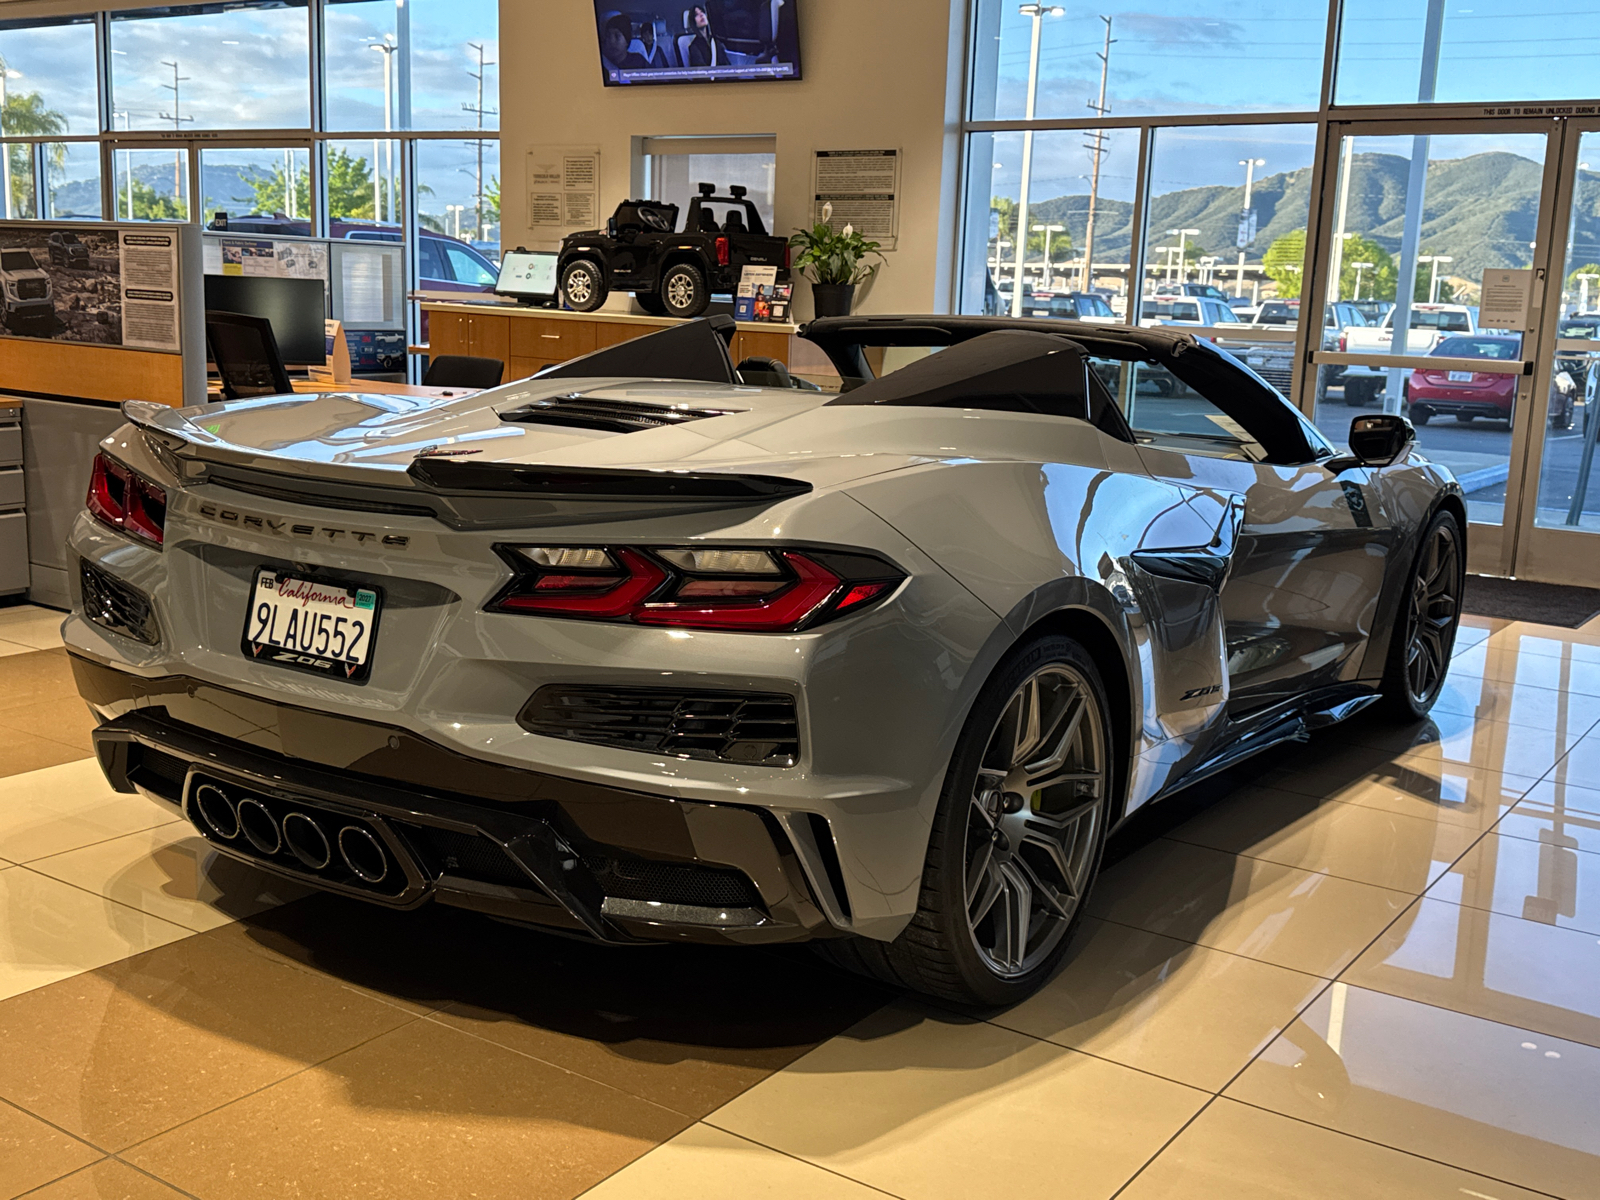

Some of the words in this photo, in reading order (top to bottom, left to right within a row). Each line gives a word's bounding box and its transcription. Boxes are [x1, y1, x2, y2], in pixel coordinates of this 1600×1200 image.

[1523, 107, 1543, 115] REMAIN
[1576, 106, 1595, 114] DURING
[200, 505, 411, 547] CORVETTE
[260, 577, 275, 589] FEB
[278, 577, 354, 609] California
[358, 593, 372, 603] 2027
[252, 602, 366, 663] 9LAU552
[272, 651, 333, 670] Z06
